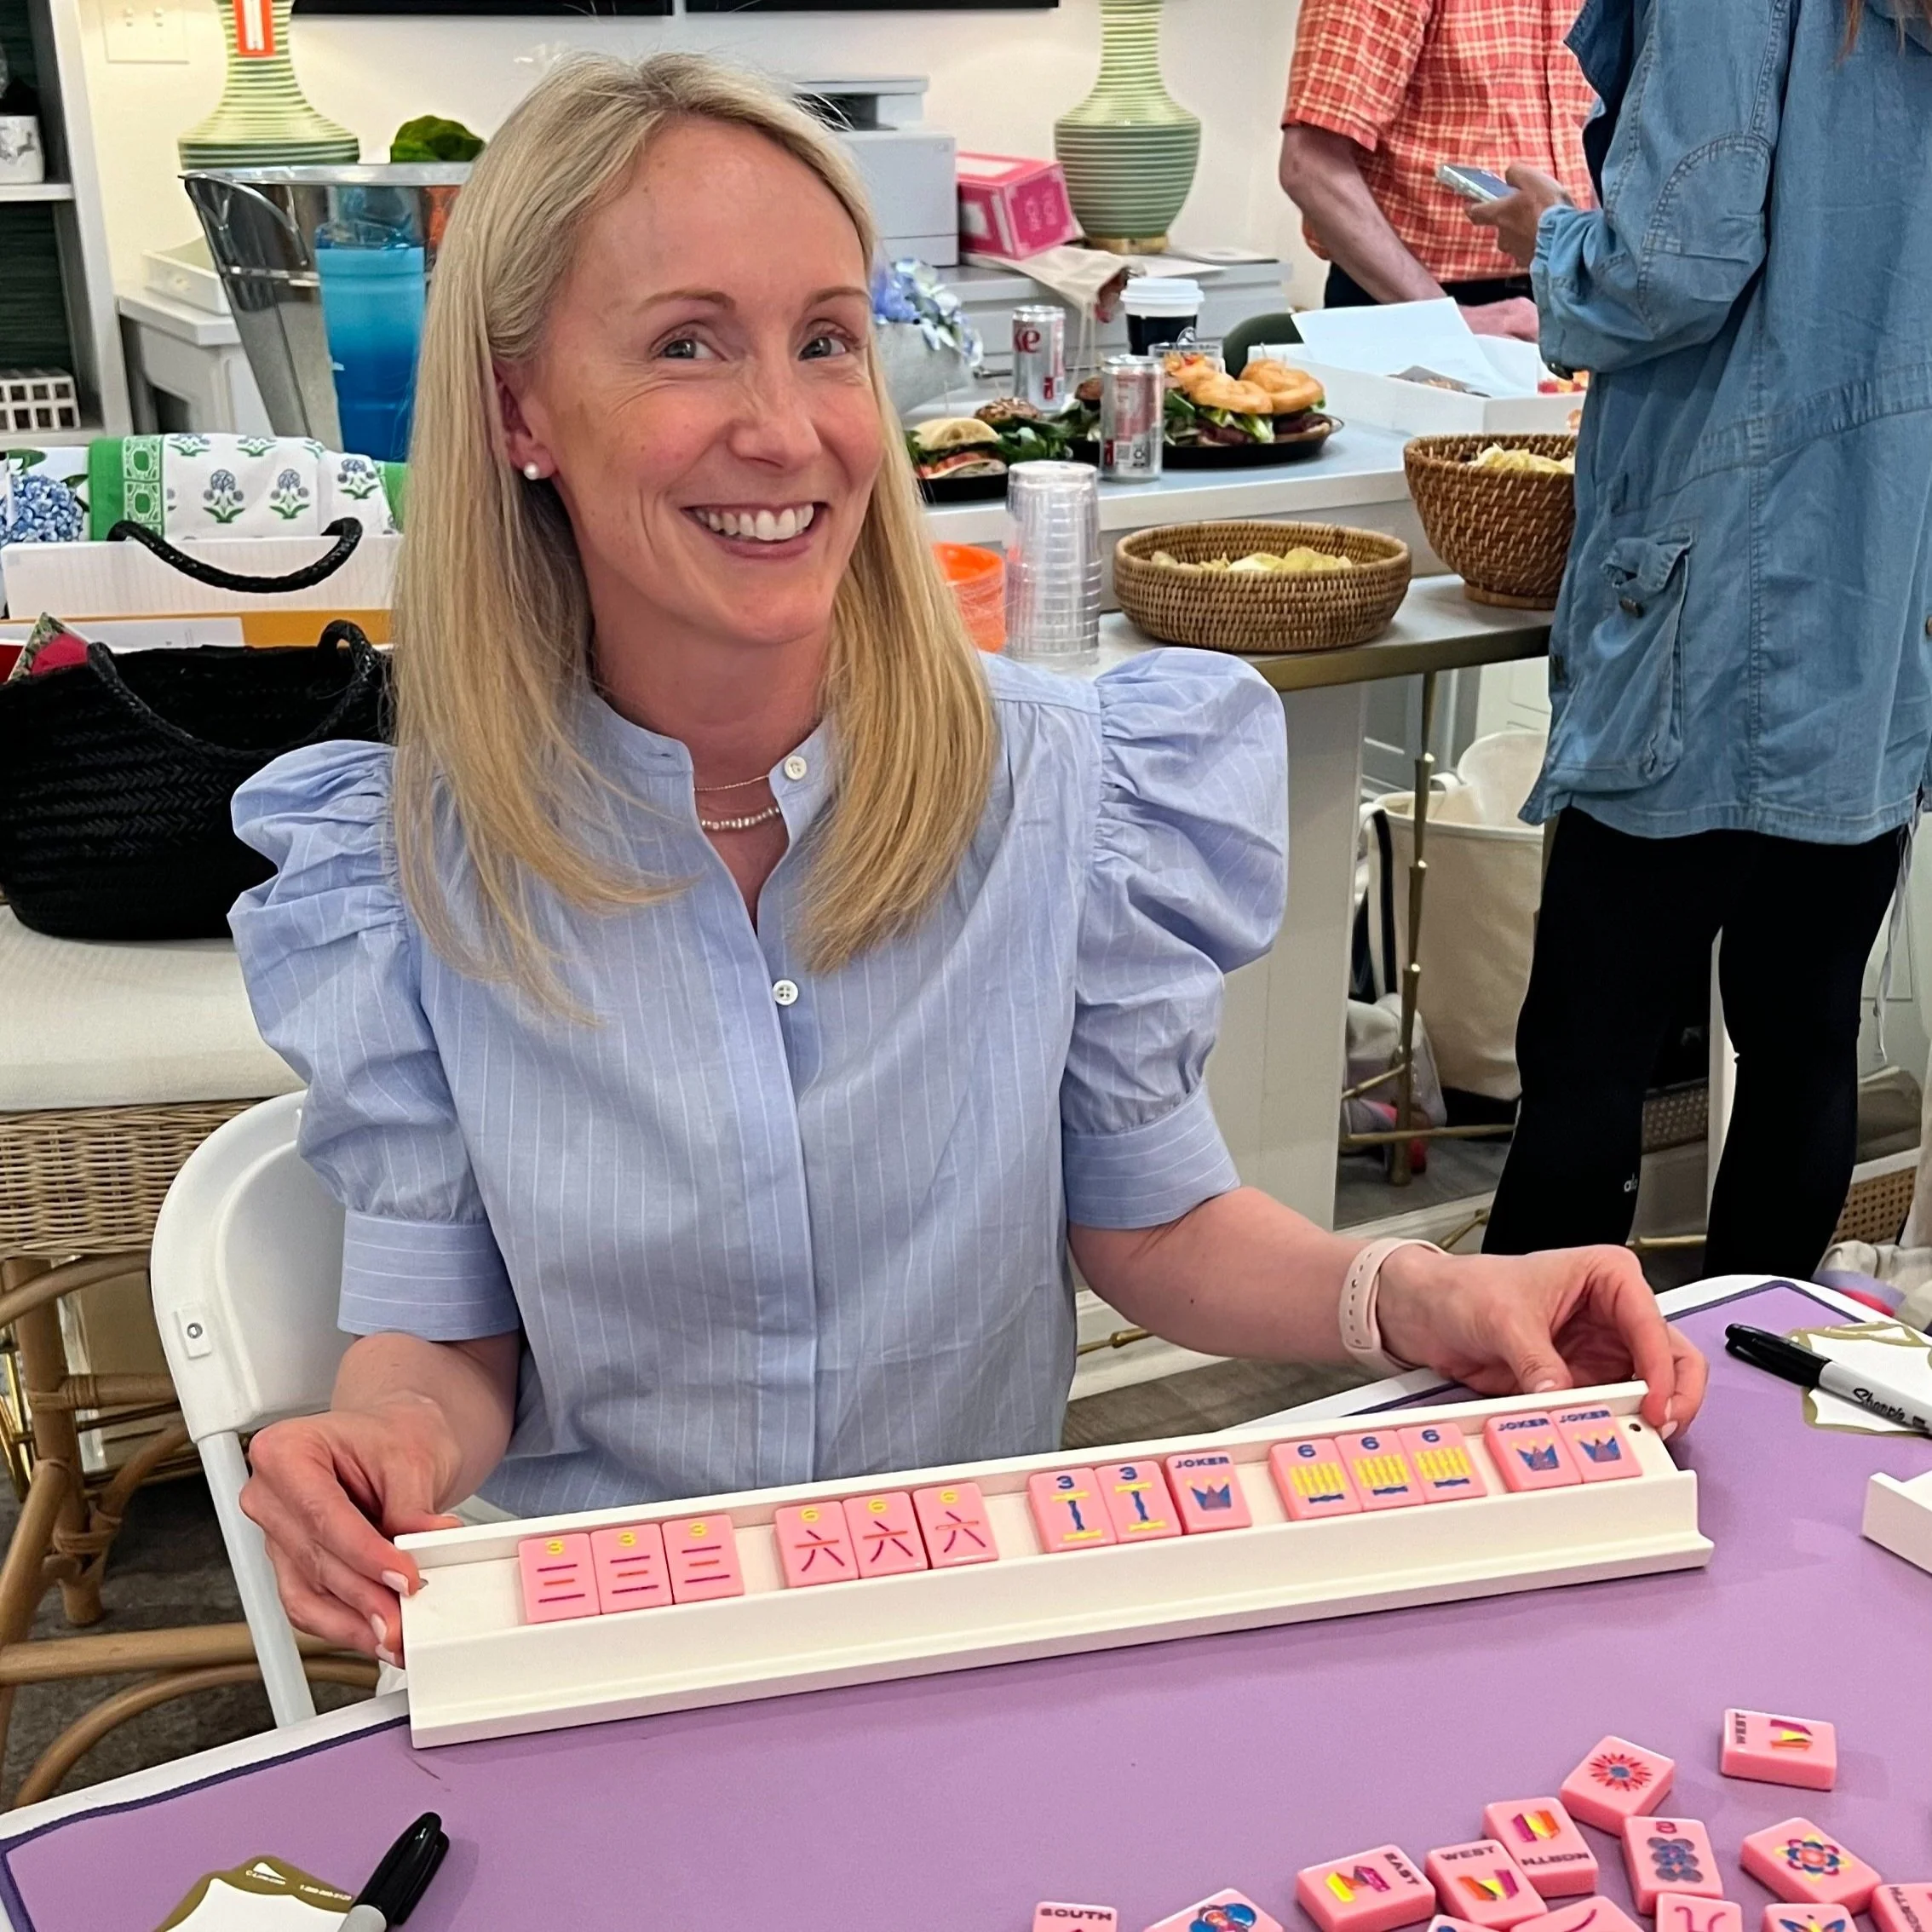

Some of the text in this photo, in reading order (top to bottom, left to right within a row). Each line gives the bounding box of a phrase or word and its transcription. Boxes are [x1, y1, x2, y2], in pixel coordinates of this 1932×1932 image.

[1560, 1410, 1611, 1423] JOKER
[1498, 1417, 1550, 1432] JOKER
[1360, 1436, 1379, 1450] 6
[1422, 1429, 1440, 1442] 6
[1297, 1444, 1316, 1458] 6
[1176, 1457, 1230, 1469] JOKER
[1119, 1467, 1138, 1481] 3
[1056, 1475, 1075, 1489] 3
[940, 1490, 959, 1504] 6
[868, 1499, 888, 1514] 6
[801, 1508, 819, 1523] 6
[688, 1522, 709, 1538] 3
[935, 1510, 986, 1553] 六
[545, 1539, 565, 1555] 3
[618, 1532, 637, 1548] 3
[863, 1521, 913, 1562] 六
[794, 1530, 845, 1572] 六
[681, 1545, 731, 1584] 三
[609, 1555, 659, 1594] 三
[537, 1564, 585, 1603] 三
[1735, 1712, 1746, 1744] WEST
[1440, 1845, 1495, 1860] WEST
[1521, 1852, 1590, 1866] NORTH
[1383, 1853, 1420, 1884] EAST
[1041, 1908, 1112, 1921] SOUTH
